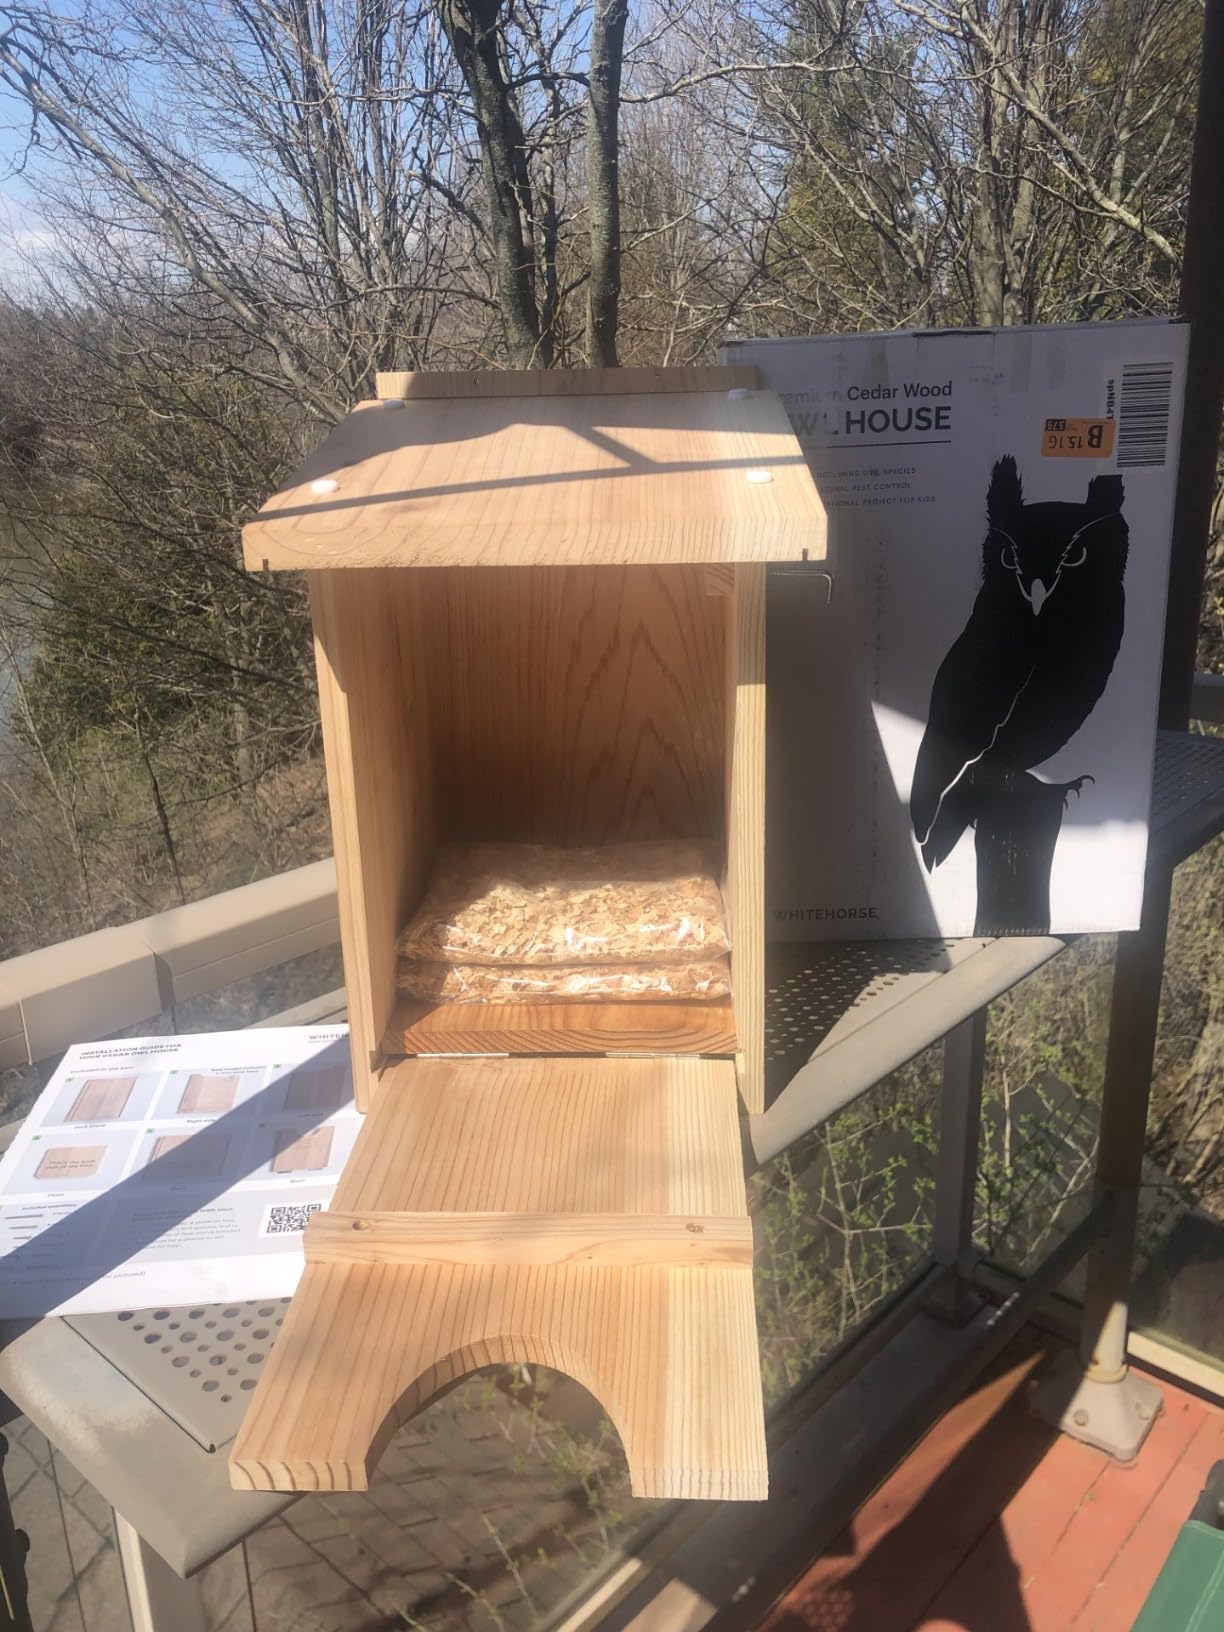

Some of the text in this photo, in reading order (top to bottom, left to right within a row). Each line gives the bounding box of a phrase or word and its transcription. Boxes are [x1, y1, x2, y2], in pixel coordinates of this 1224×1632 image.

[847, 384, 898, 400] Cedar
[903, 381, 952, 397] Wood
[846, 406, 952, 434] HOUSE
[1087, 425, 1103, 449] B
[873, 481, 912, 491] CONTROL
[862, 497, 897, 506] PROJECT
[773, 906, 878, 921] WHITEHORSE
[80, 1047, 138, 1056] INSTALLATION
